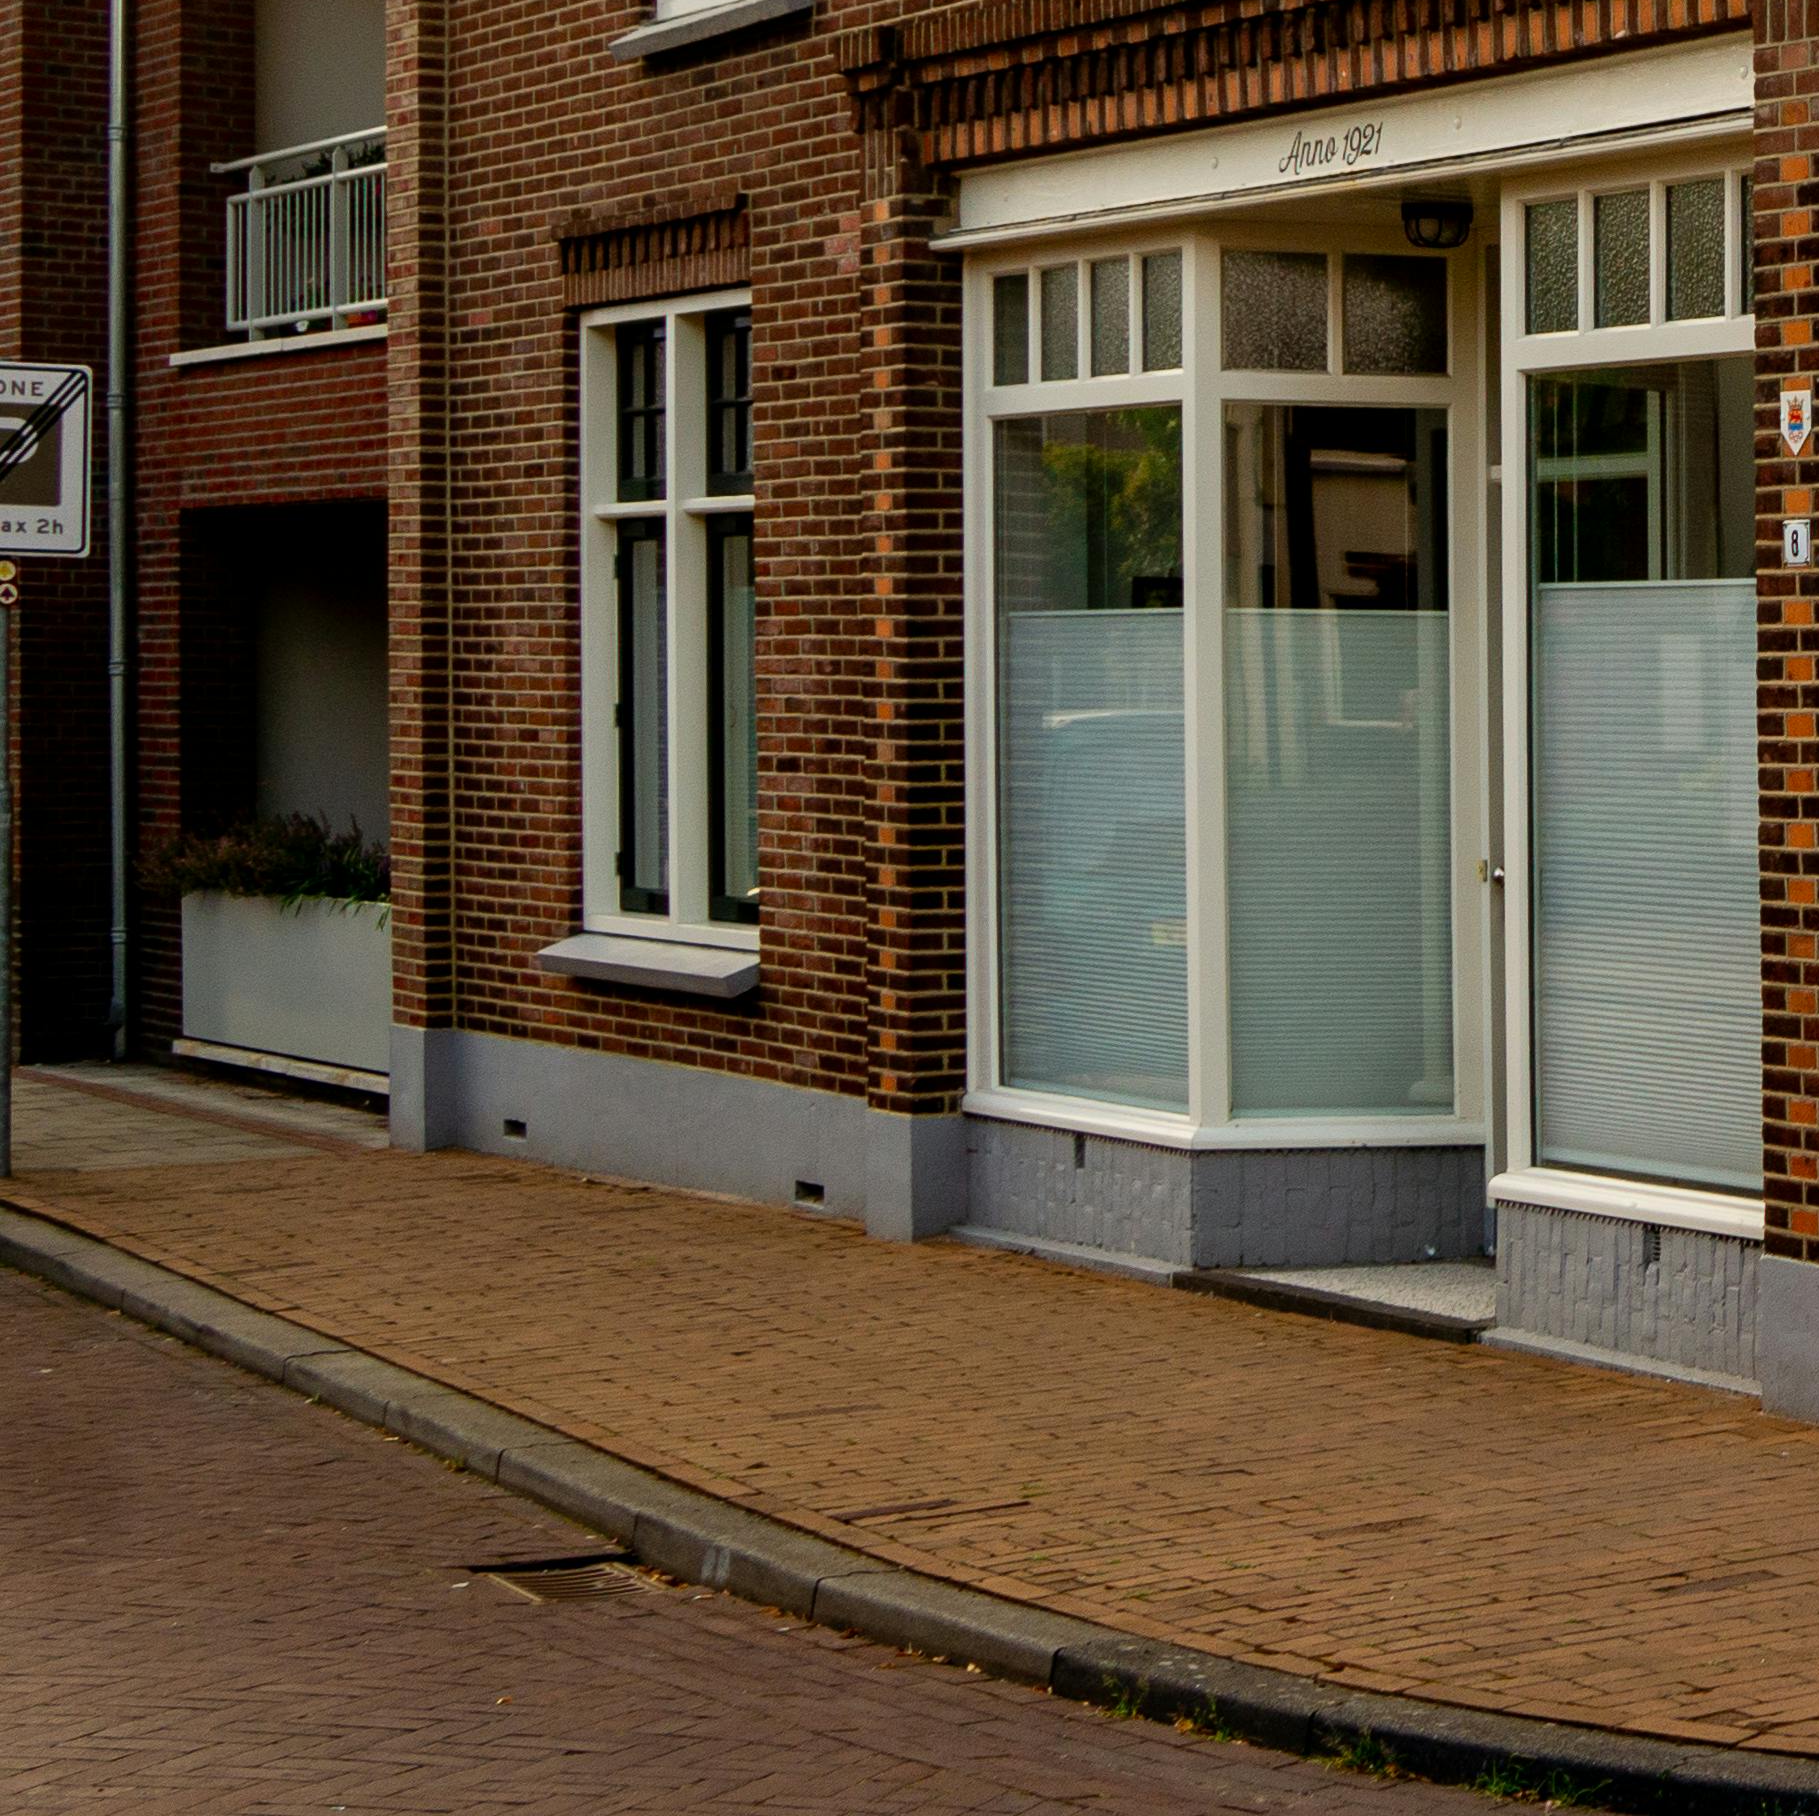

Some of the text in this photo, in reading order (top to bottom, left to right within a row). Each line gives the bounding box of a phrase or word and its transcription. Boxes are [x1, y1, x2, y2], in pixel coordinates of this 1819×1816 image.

[1278, 121, 1384, 176] Anno 1921
[36, 518, 64, 535] 2h
[1791, 529, 1799, 557] 8
